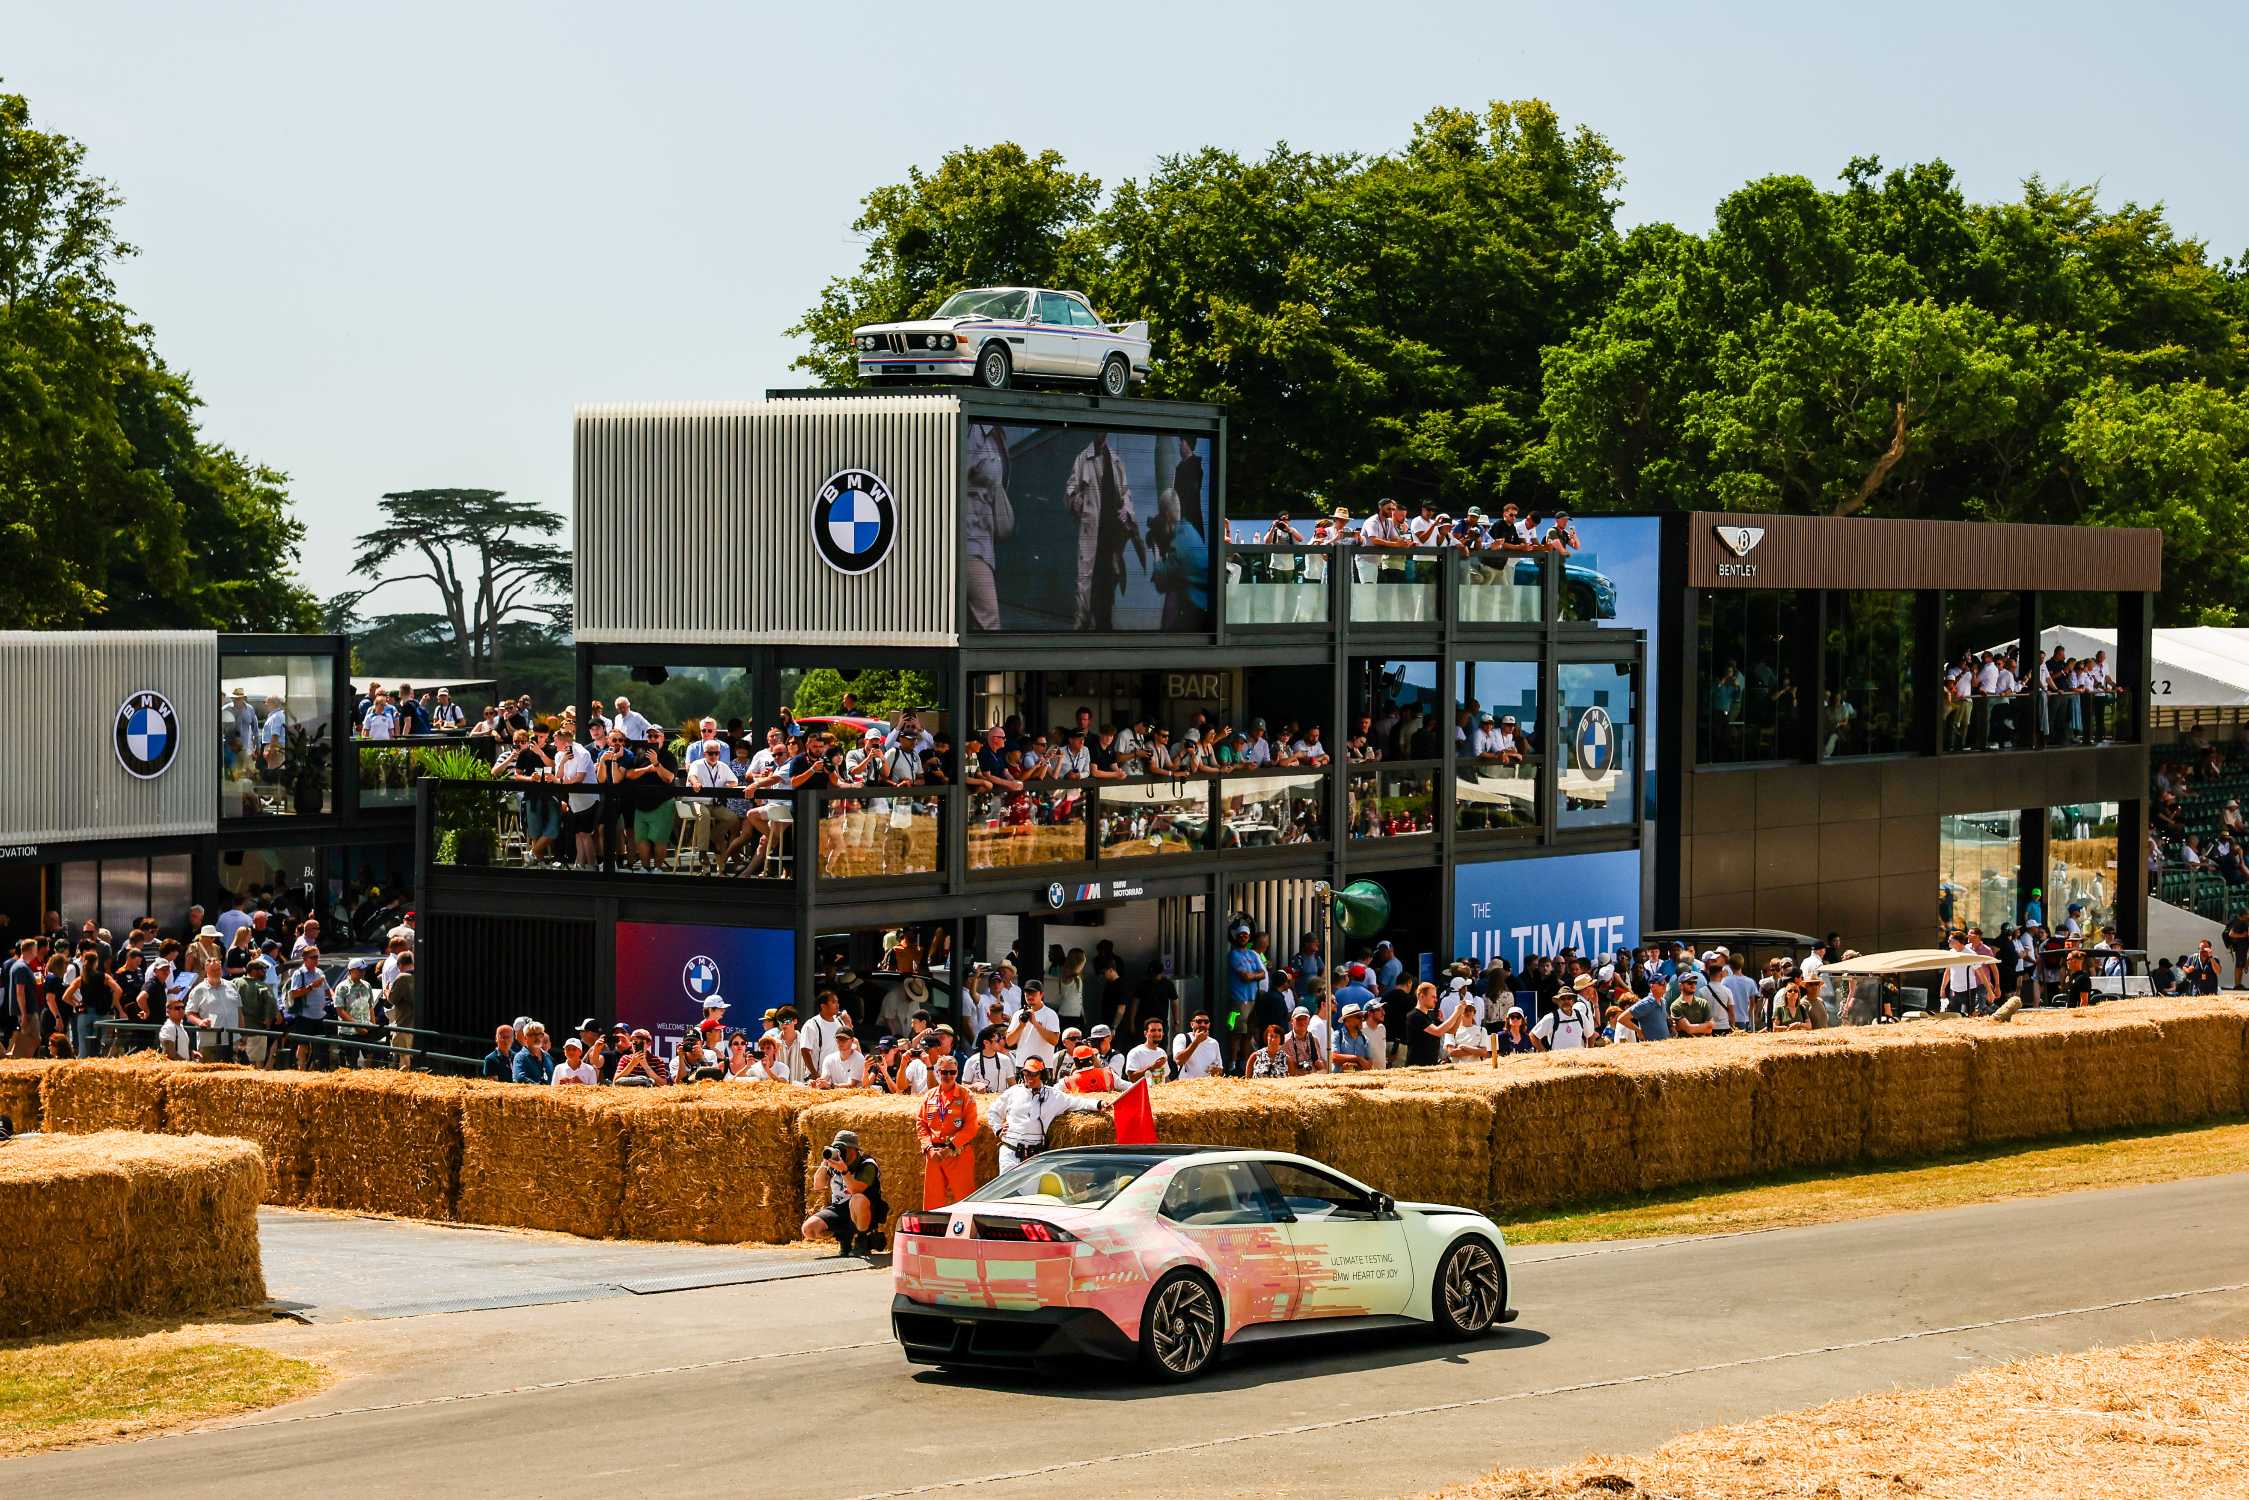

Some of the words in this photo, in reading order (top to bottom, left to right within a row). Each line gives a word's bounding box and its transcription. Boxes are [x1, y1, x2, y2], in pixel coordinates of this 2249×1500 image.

[823, 474, 886, 504] BMW
[1719, 564, 1757, 576] BENTLEY
[1168, 674, 1219, 698] BAR
[2161, 680, 2172, 695] 2
[123, 695, 171, 720] BMW
[1582, 710, 1610, 732] BMW
[1113, 888, 1144, 897] MOTORRAD
[1471, 903, 1492, 919] THE
[688, 958, 716, 972] BMW
[656, 1022, 685, 1031] WELCOME
[1331, 1255, 1364, 1266] ULTIMATE
[1332, 1271, 1349, 1282] BMW
[1352, 1270, 1375, 1280] HEART
[1375, 1269, 1385, 1279] OF
[1386, 1268, 1398, 1279] JOY
